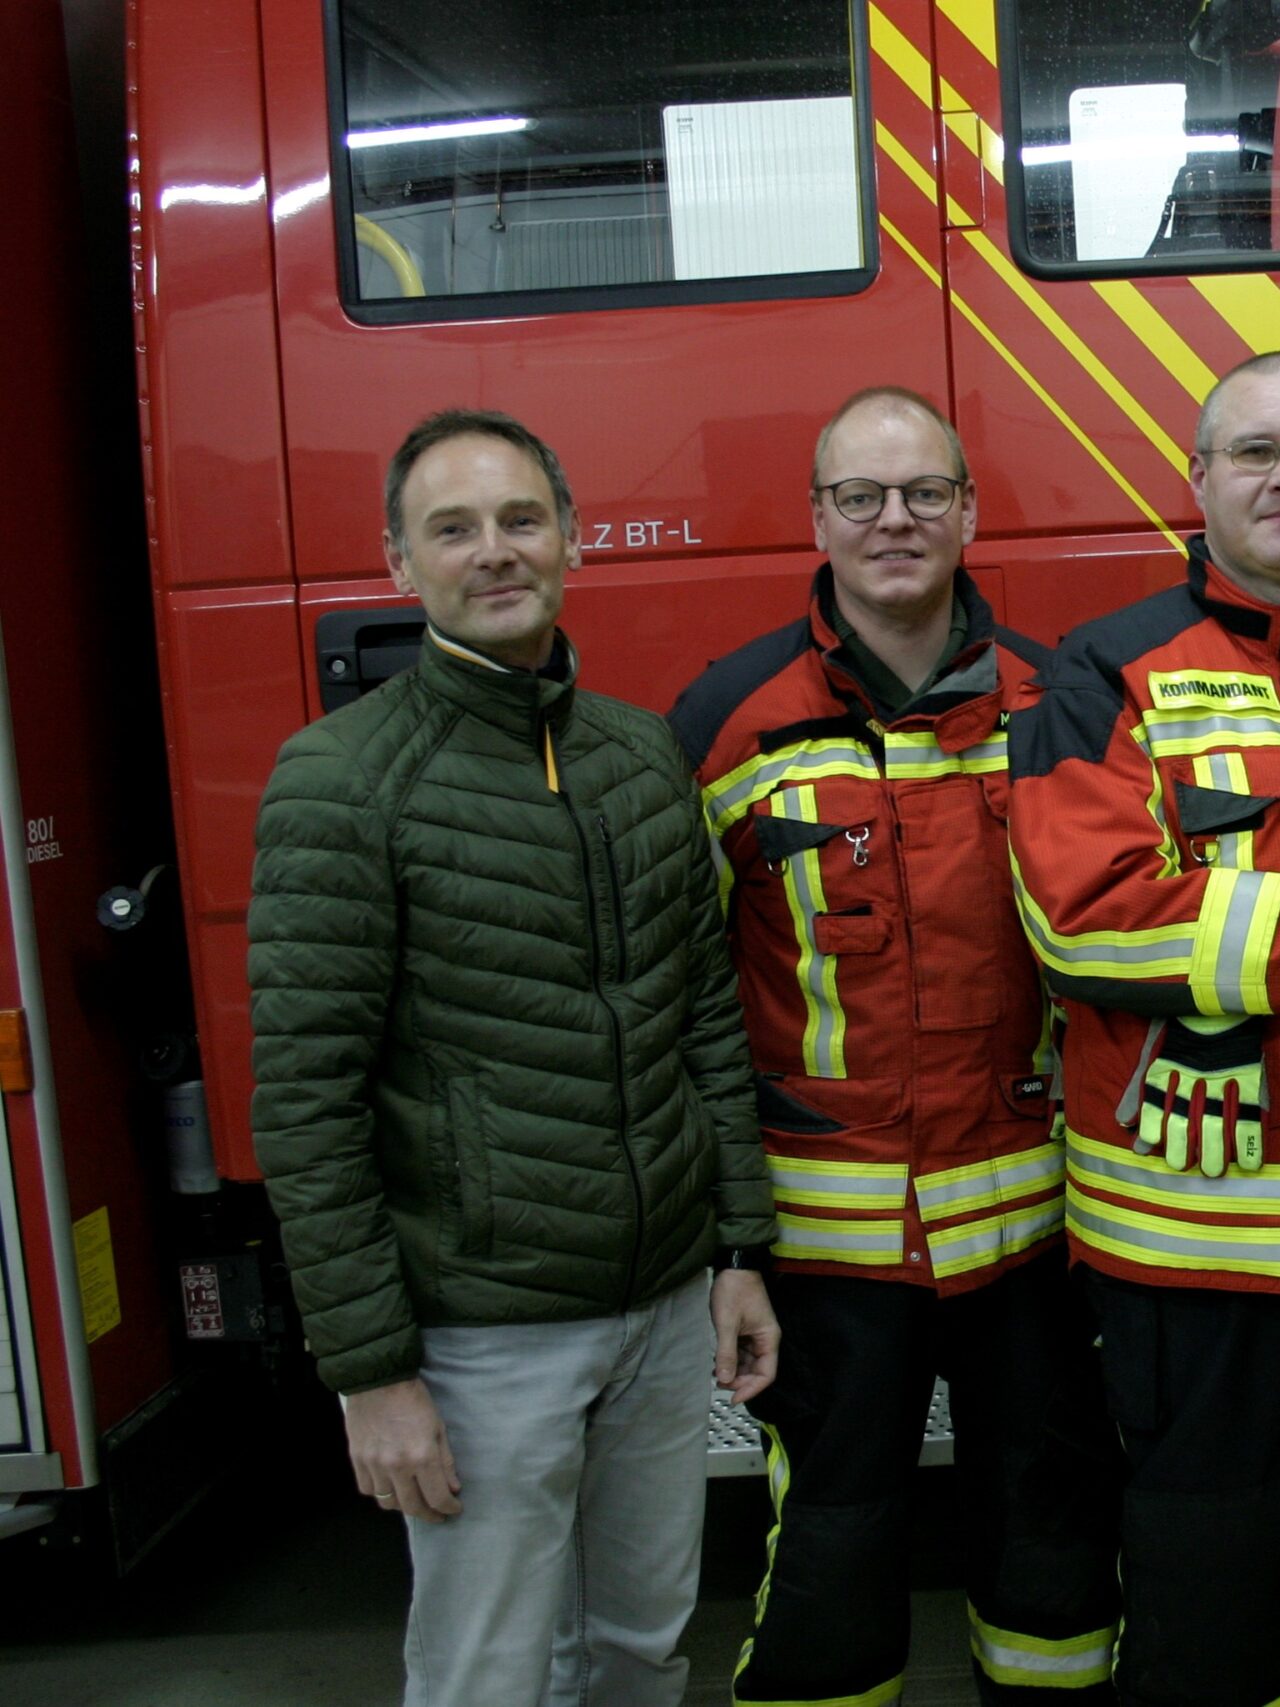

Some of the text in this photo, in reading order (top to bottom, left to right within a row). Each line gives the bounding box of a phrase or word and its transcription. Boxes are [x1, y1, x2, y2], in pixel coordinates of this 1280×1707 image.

[625, 519, 702, 547] BT-L
[1158, 680, 1270, 699] KOMMANDANT
[26, 841, 64, 864] DIESEL
